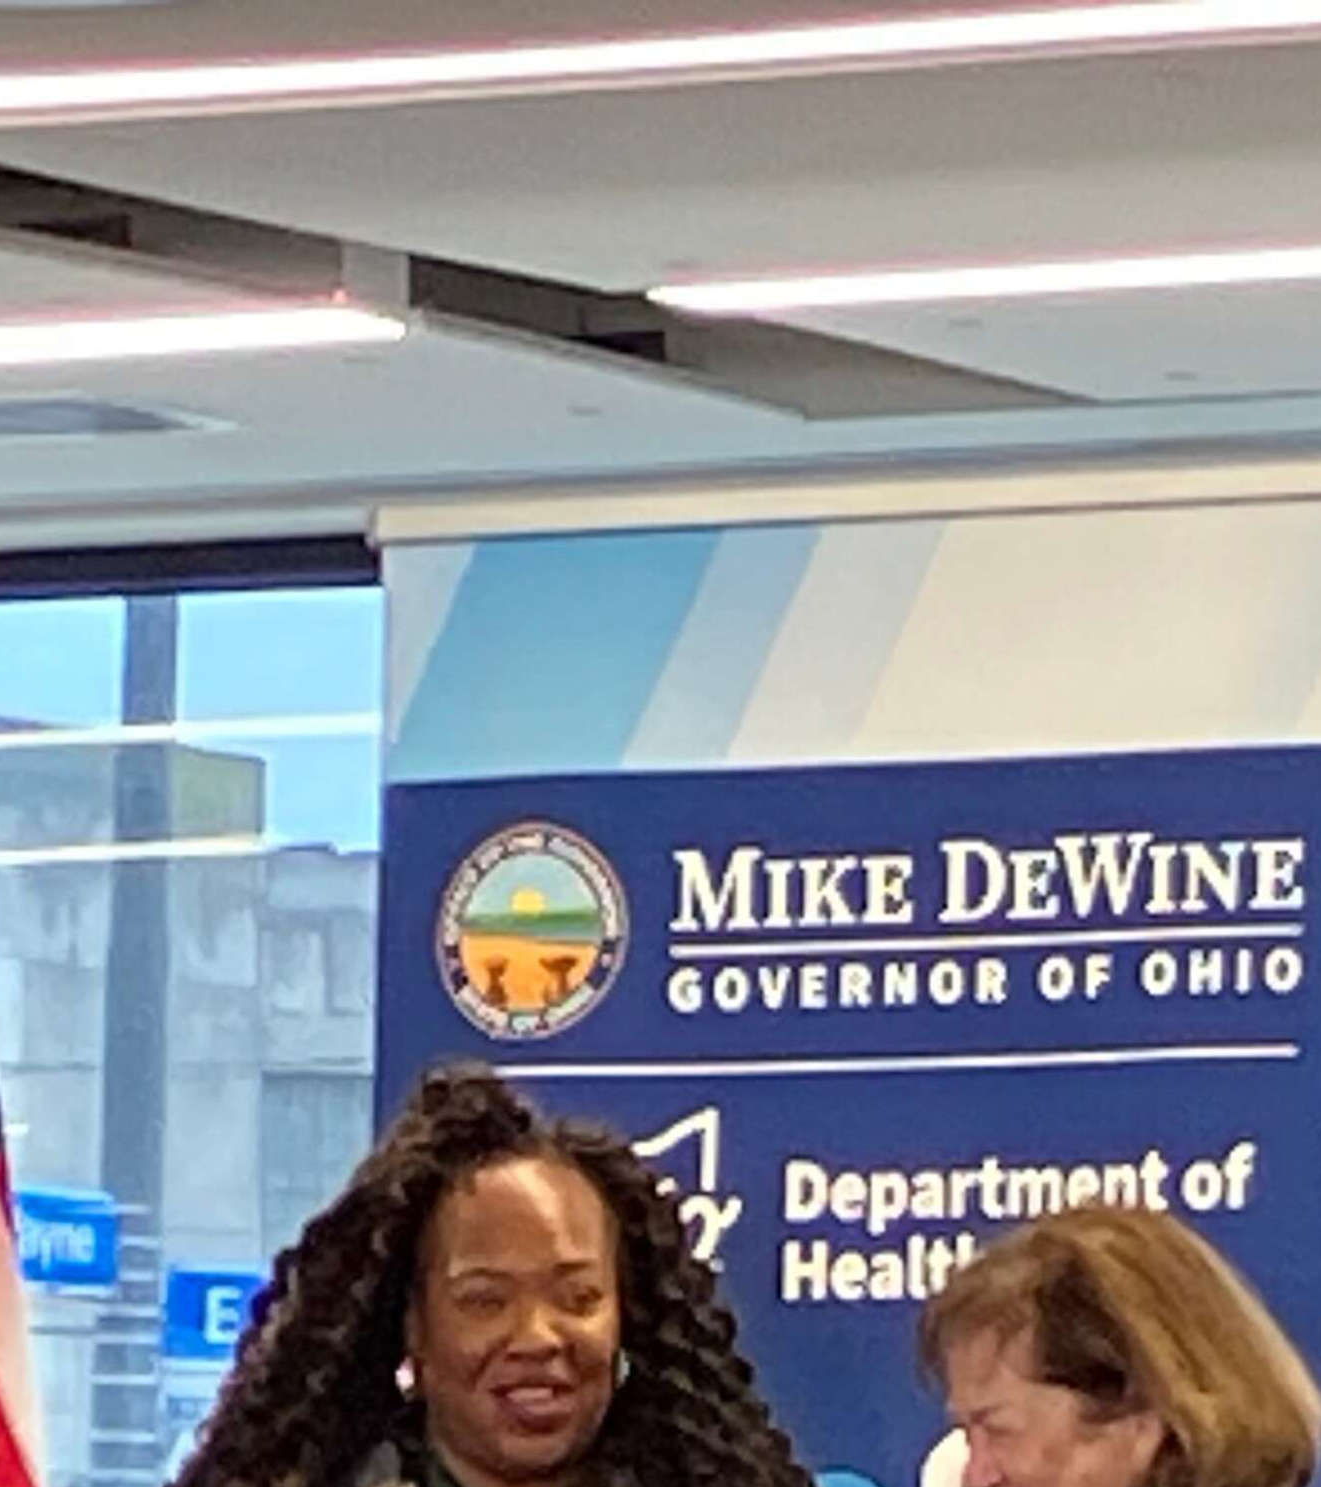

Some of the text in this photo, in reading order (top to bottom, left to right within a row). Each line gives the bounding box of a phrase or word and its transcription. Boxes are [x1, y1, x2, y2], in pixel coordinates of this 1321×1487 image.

[668, 846, 914, 933] MIKE
[667, 947, 1303, 1013] GOVERNOR OF OHIO
[783, 1141, 1257, 1236] Department of
